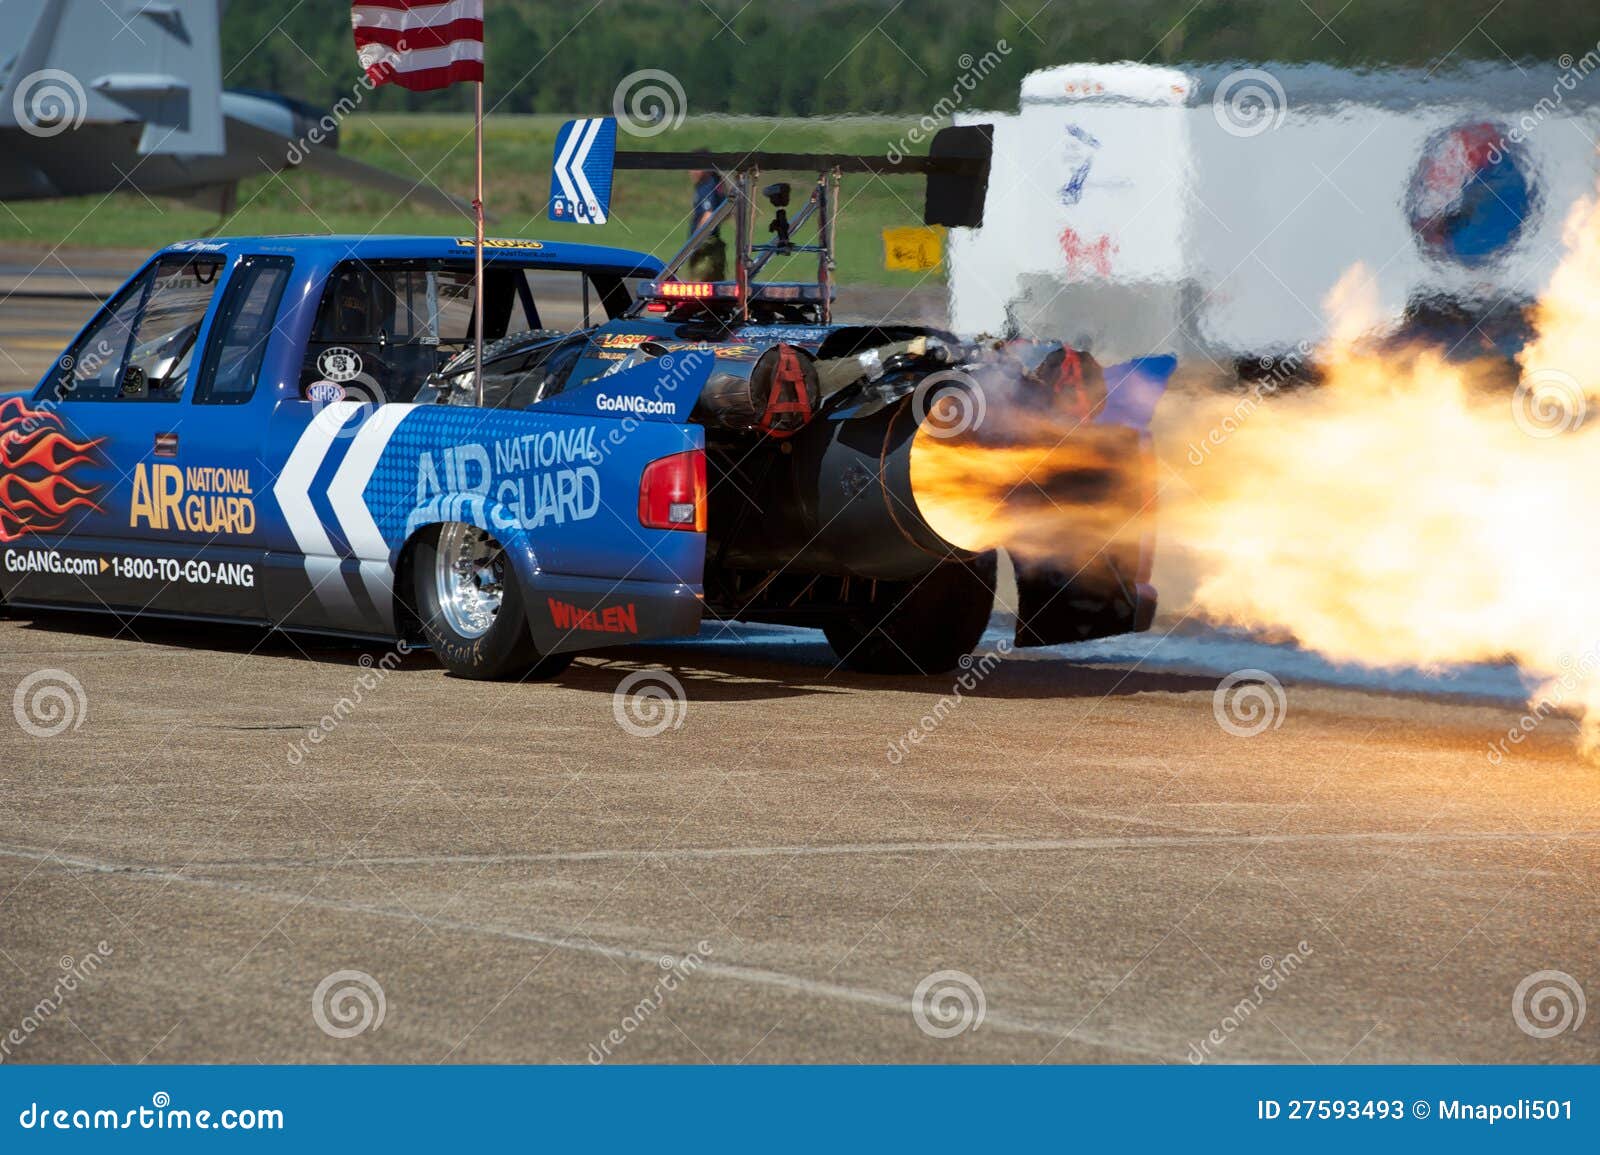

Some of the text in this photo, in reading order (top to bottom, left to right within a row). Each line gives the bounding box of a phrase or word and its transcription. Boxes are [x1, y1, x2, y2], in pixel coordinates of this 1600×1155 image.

[310, 384, 342, 402] NHRA
[596, 393, 676, 415] GoANG.com
[495, 426, 596, 474] NATIONAL
[130, 462, 187, 531] AIR
[186, 466, 253, 495] NATIONAL
[491, 466, 600, 530] GUARD
[185, 496, 256, 535] GUARD
[4, 549, 254, 587] GoANG.com 1-800-TO-GO-ANG
[548, 598, 638, 634] WHELEN
